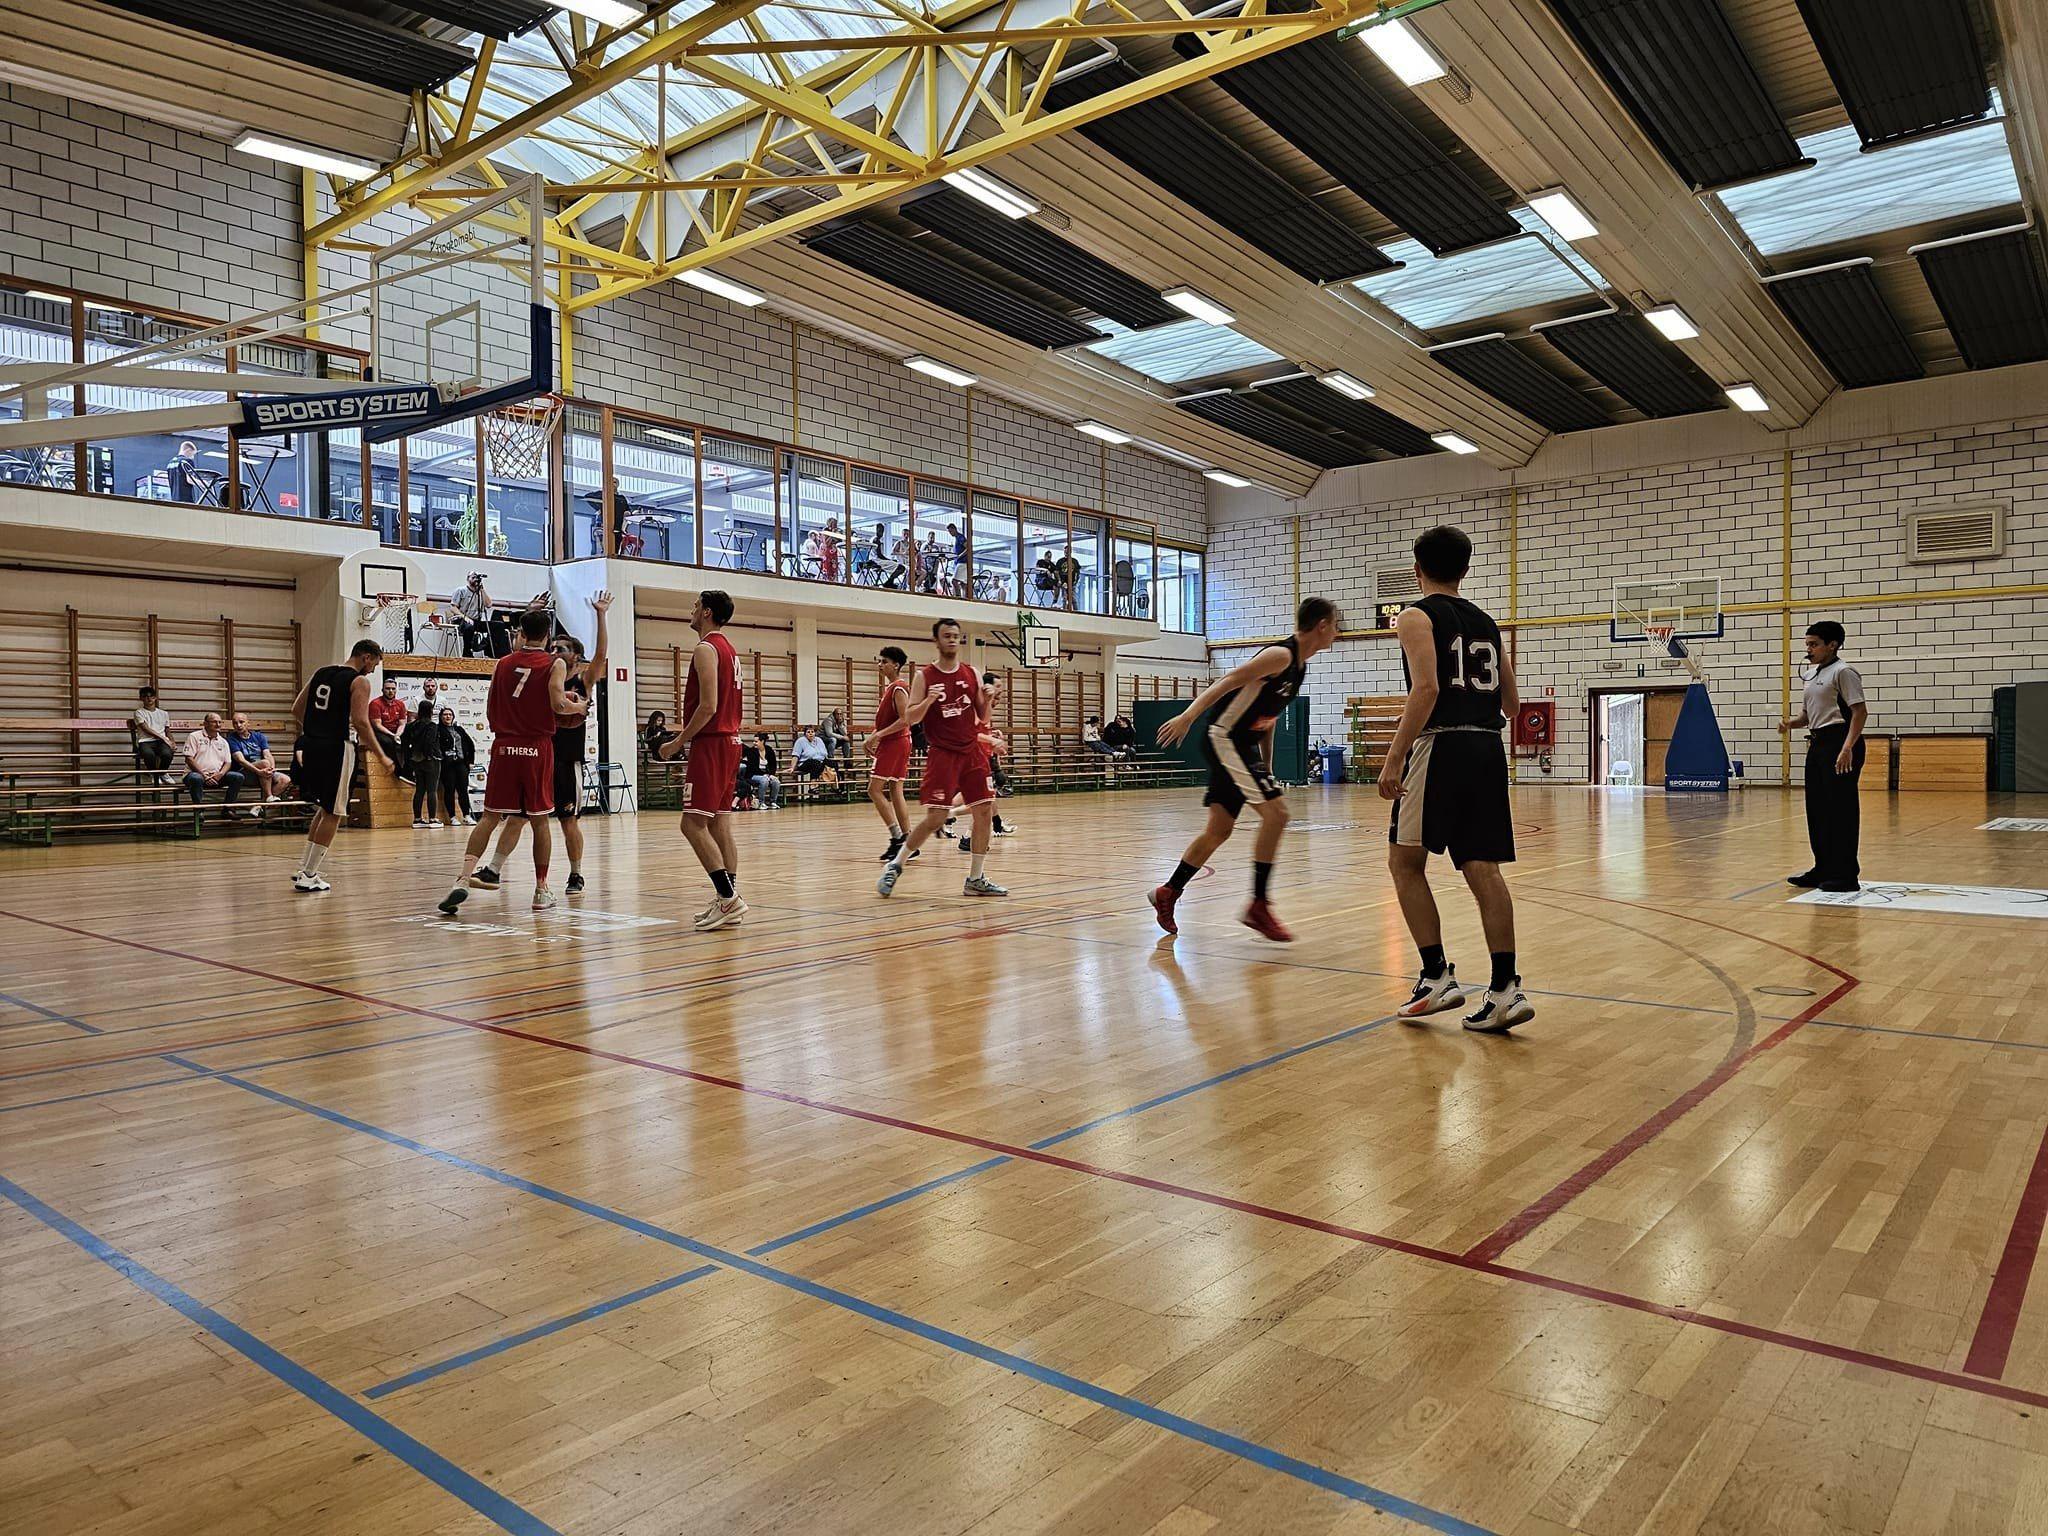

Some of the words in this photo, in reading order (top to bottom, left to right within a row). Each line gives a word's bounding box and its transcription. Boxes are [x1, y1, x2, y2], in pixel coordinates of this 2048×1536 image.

[1450, 635, 1500, 692] 13
[512, 667, 532, 698] 7
[315, 684, 331, 710] 9
[506, 746, 539, 757] THERSA
